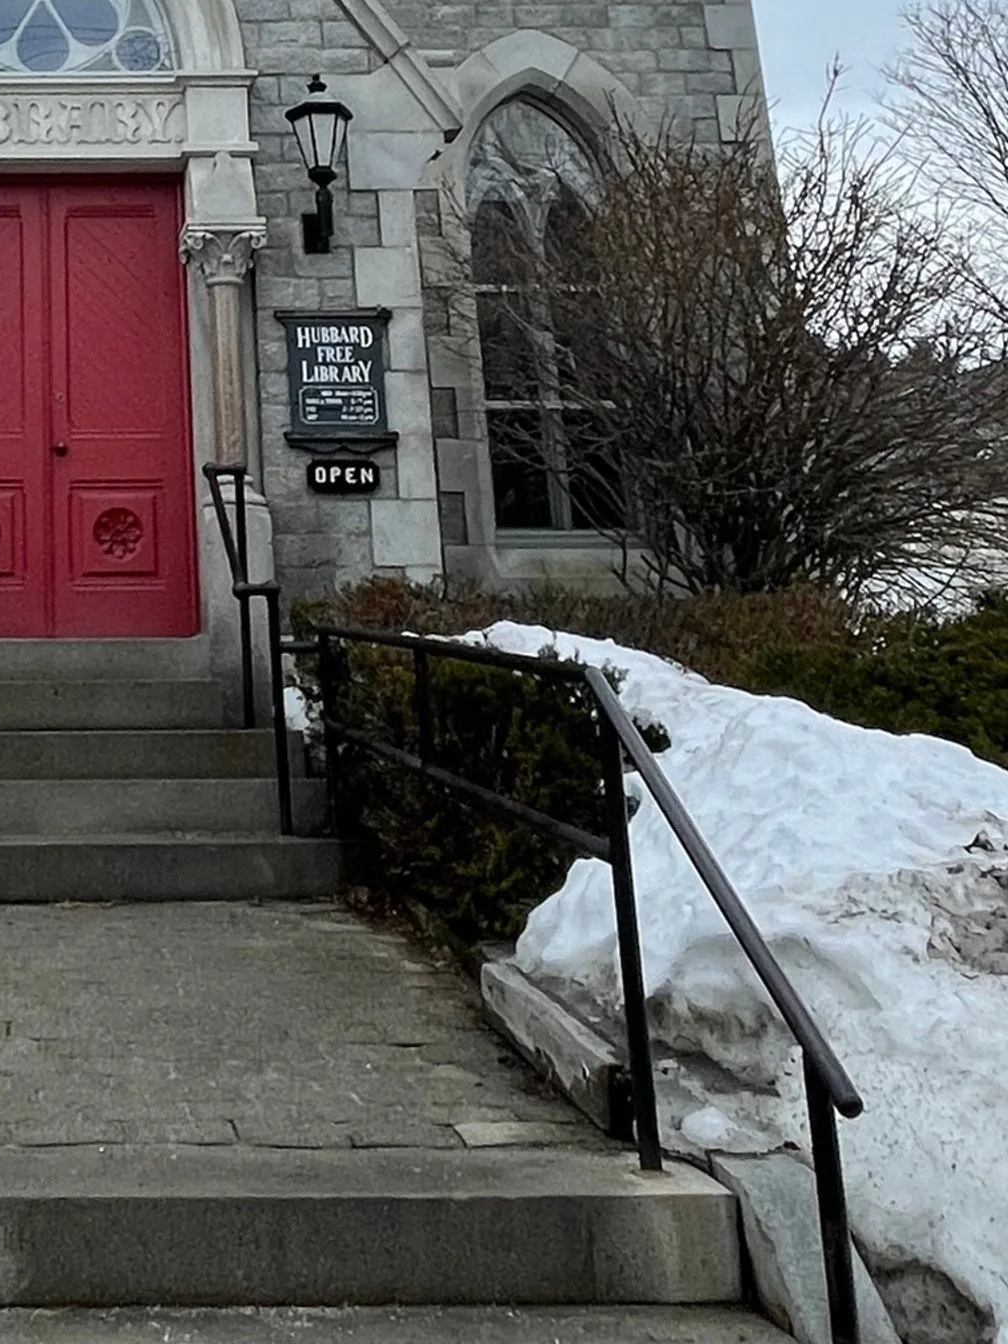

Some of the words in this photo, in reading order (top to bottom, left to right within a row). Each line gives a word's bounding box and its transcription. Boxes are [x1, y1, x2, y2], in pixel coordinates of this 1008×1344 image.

[297, 326, 374, 348] HUBBARD
[317, 345, 355, 363] FREE
[301, 360, 372, 383] LIBRARY
[314, 466, 374, 484] OPEN
